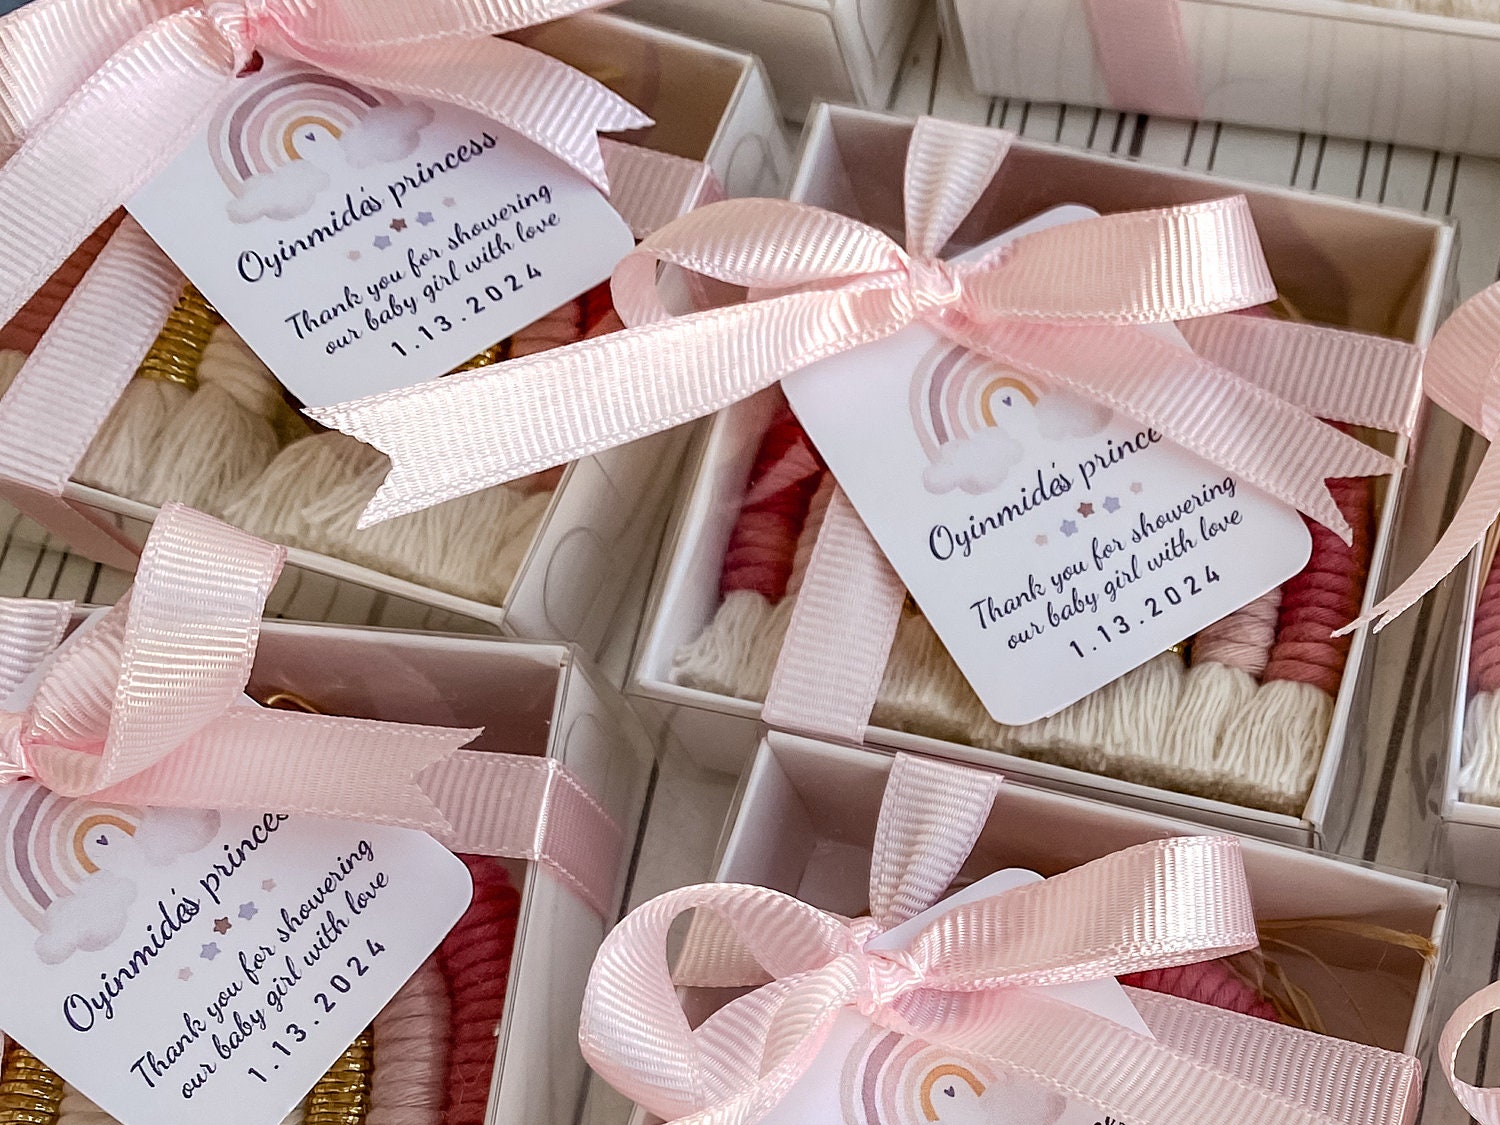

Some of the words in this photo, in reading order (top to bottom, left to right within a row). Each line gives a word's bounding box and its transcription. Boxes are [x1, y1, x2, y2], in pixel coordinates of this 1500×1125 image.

[388, 132, 498, 208] princess
[283, 285, 363, 339] Thank
[366, 271, 405, 301] you
[407, 247, 442, 278] for
[447, 185, 551, 250] showering
[325, 328, 363, 354] our
[364, 293, 417, 331] baby
[422, 259, 459, 303] girl
[465, 232, 515, 273] with
[515, 212, 560, 242] love
[390, 263, 542, 356] 1.13.2024
[1078, 427, 1162, 490] prince
[968, 573, 1046, 629] Thank
[1050, 561, 1088, 594] you
[1091, 536, 1125, 571] for
[1131, 477, 1237, 543] showering
[1007, 622, 1045, 649] our
[1046, 586, 1098, 627] baby
[1103, 553, 1140, 602] girl
[1146, 526, 1197, 570] with
[1199, 509, 1242, 540] love
[1070, 565, 1220, 658] 1.13.2024
[199, 812, 289, 905] prince
[130, 1012, 206, 1088] Thank
[207, 981, 243, 1023] you
[238, 945, 276, 984] for
[277, 840, 375, 942] showering
[181, 1063, 217, 1098] our
[210, 1009, 266, 1060] baby
[266, 954, 301, 1012] girl
[302, 909, 350, 965] with
[344, 871, 389, 914] love
[248, 939, 385, 1082] 1.13.2024
